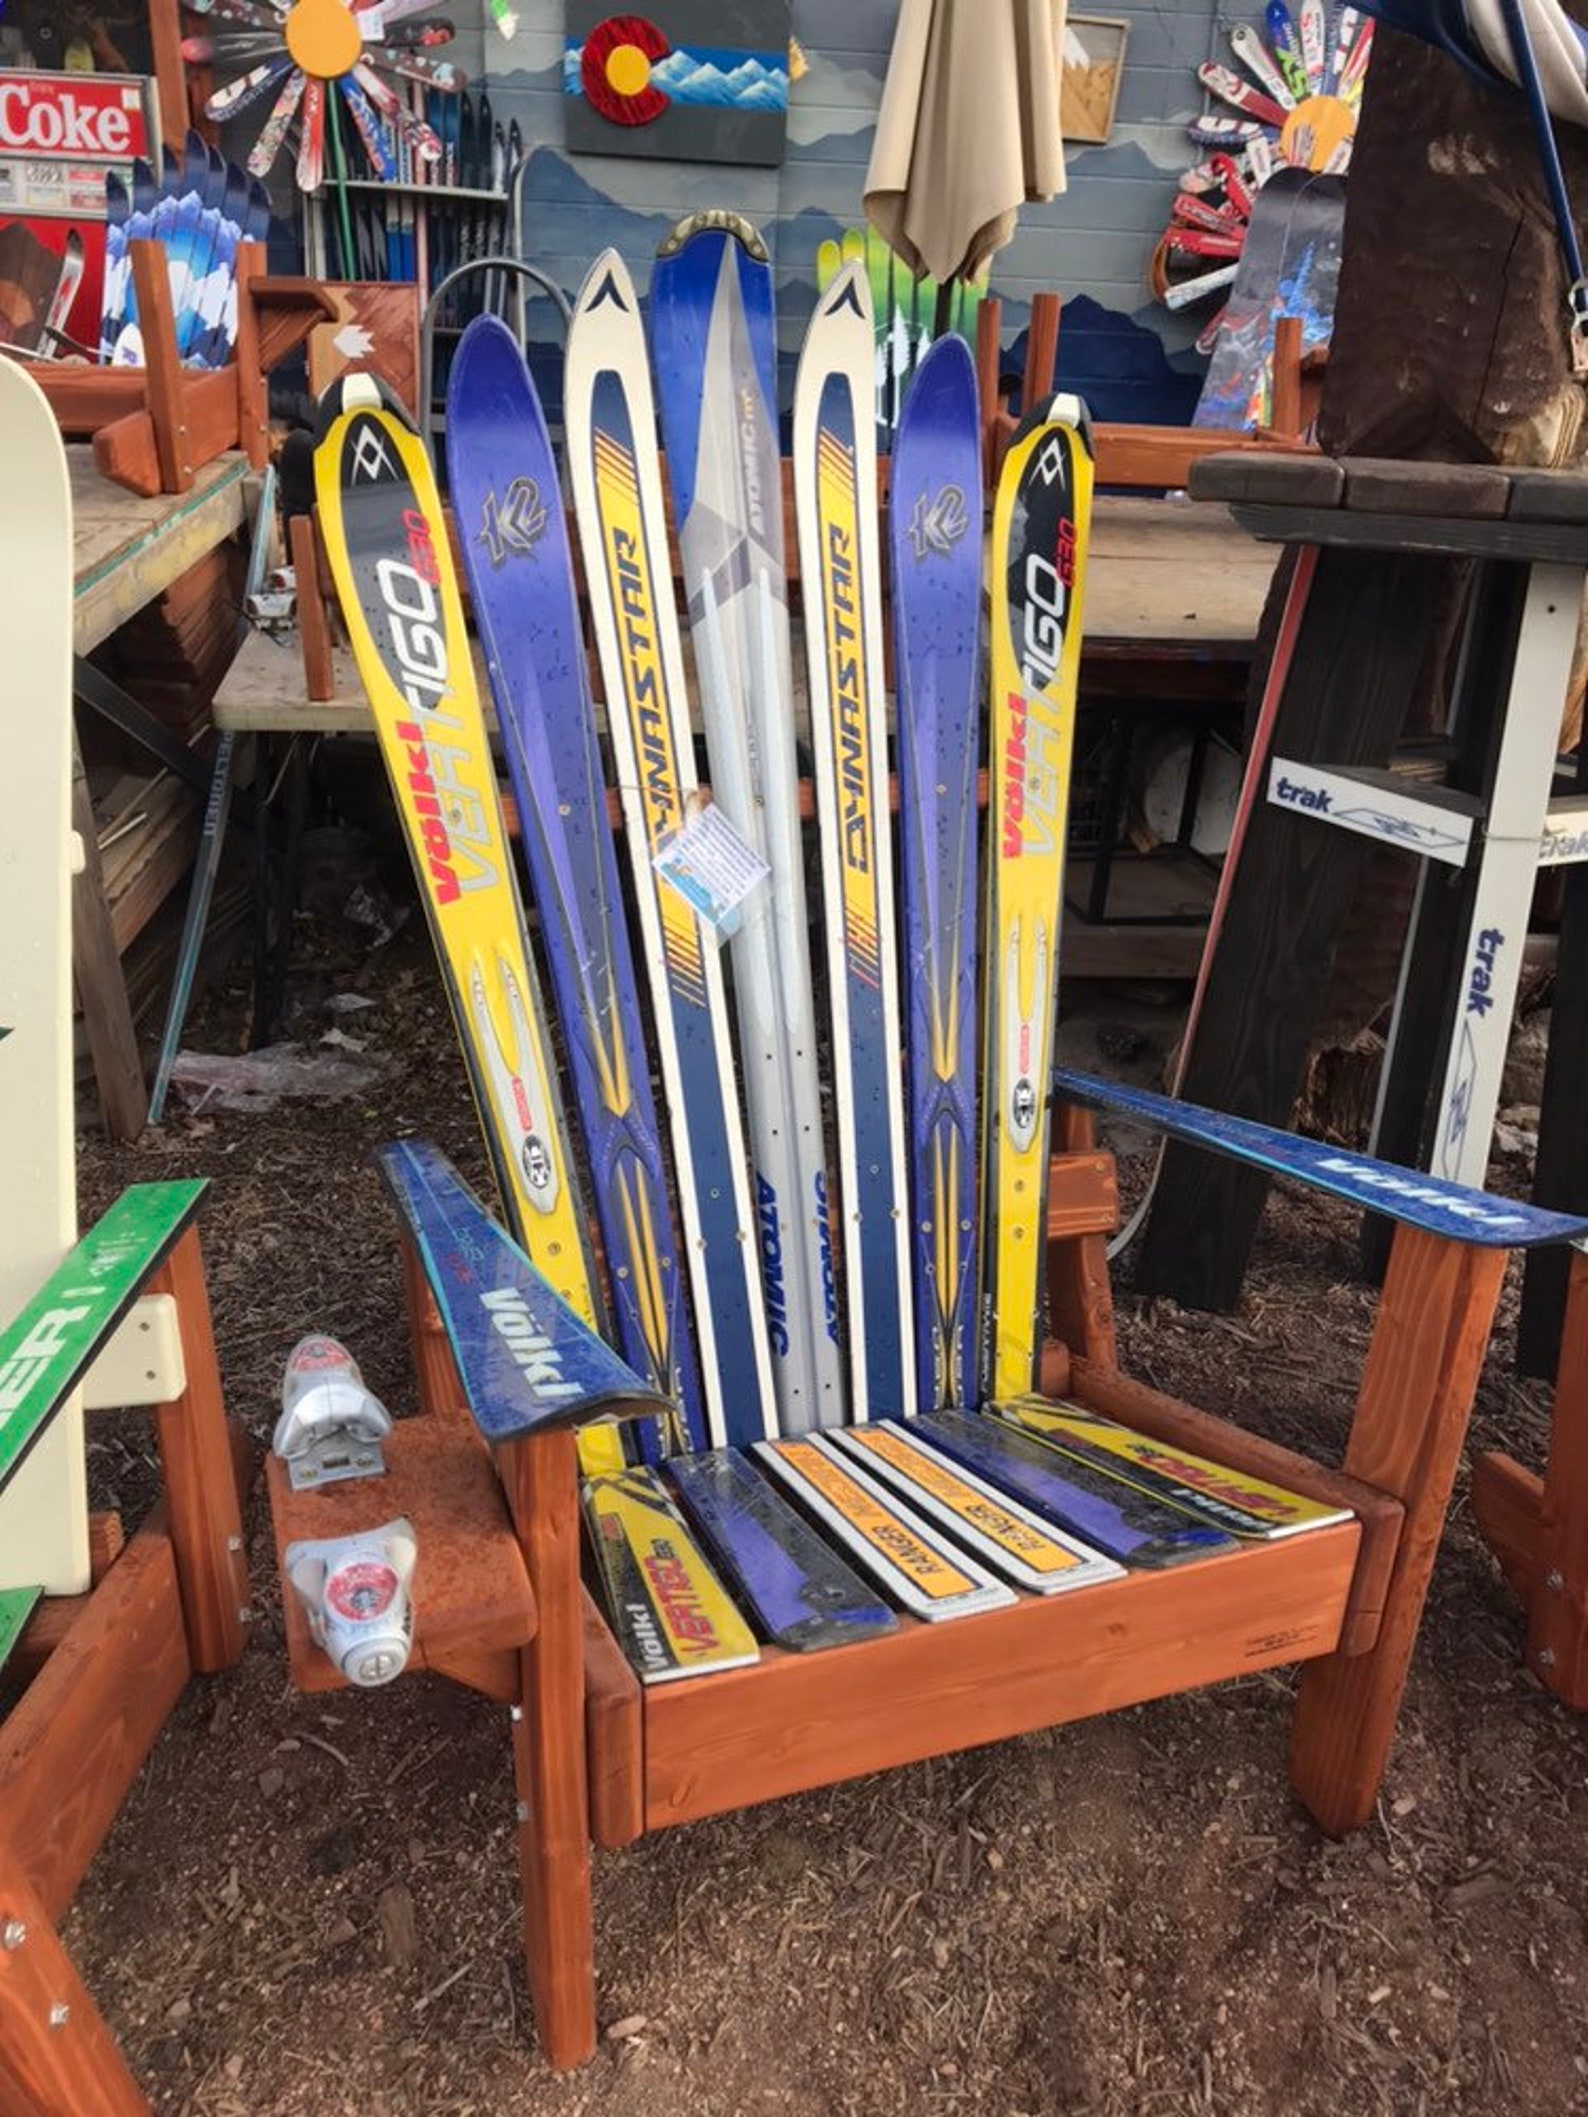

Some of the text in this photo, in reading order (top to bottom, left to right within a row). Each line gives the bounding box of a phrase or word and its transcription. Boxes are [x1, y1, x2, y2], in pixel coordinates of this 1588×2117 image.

[0, 84, 130, 151] Coke
[478, 477, 547, 564] K2
[909, 484, 967, 558] K2
[829, 522, 868, 873] DYNASTAR
[1276, 776, 1334, 813] trak
[1466, 928, 1504, 1019] trak
[757, 1170, 788, 1357] ATOMIC
[872, 1524, 944, 1575] RANGER
